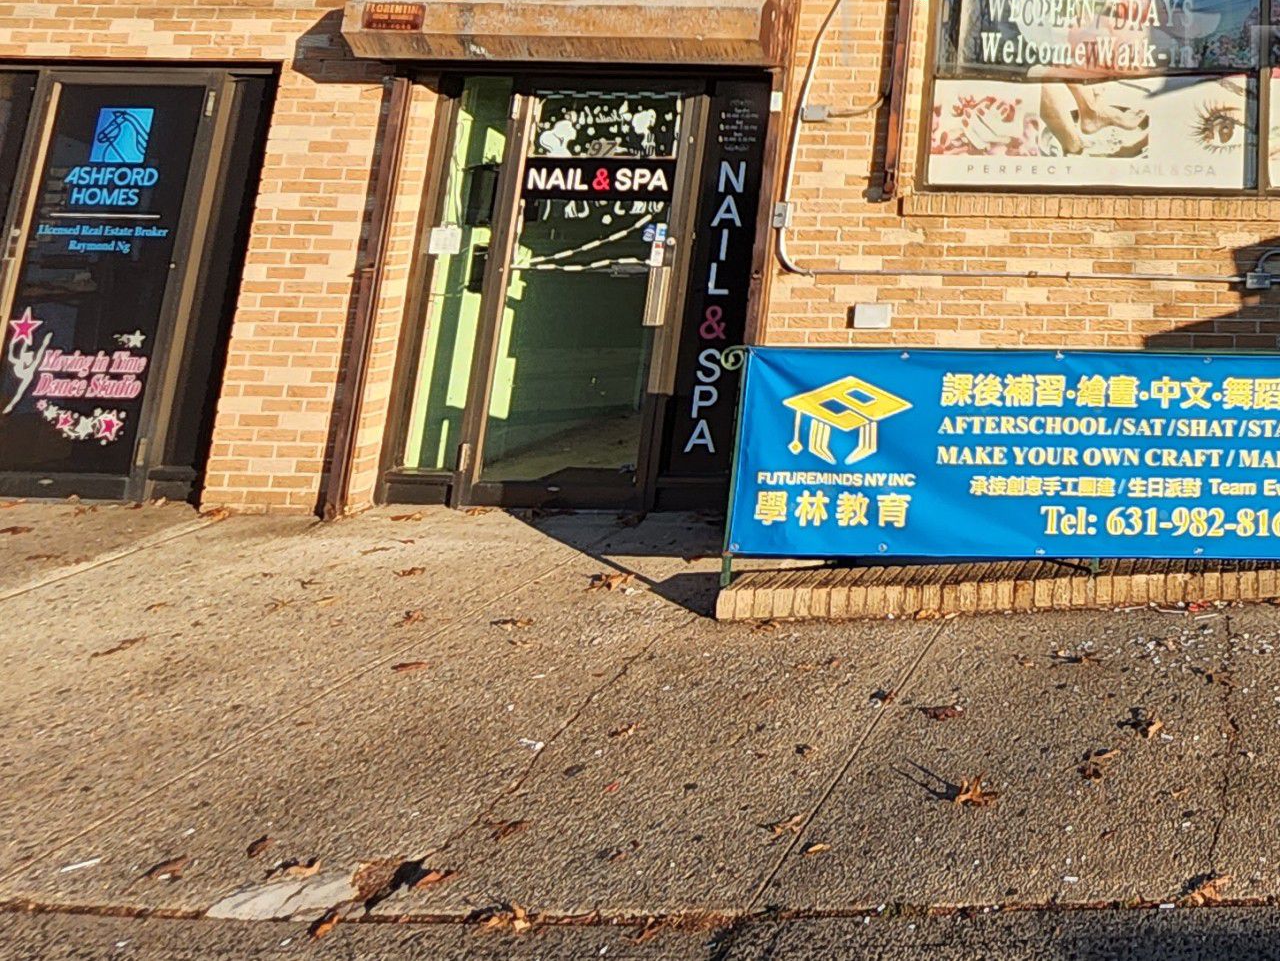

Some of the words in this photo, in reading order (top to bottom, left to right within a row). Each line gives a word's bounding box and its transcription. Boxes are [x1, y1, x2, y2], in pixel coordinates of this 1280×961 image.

[981, 32, 1086, 65] Welcome
[1096, 37, 1196, 69] Walk-in
[64, 167, 159, 186] ASHFORD
[527, 167, 588, 191] NAIL
[592, 168, 610, 191] &
[614, 168, 669, 191] SPA
[966, 164, 1072, 176] PERFECT
[70, 188, 139, 206] HOMES
[38, 224, 80, 235] Licensed
[81, 225, 102, 235] Real
[103, 225, 133, 236] Estate
[134, 226, 168, 236] Broker
[68, 240, 115, 253] Raymond
[115, 240, 131, 253] Ng
[38, 350, 95, 377] Moving
[109, 351, 147, 373] Time
[32, 372, 88, 396] Dance
[85, 373, 142, 398] Studio
[936, 446, 1007, 467] MAKE
[1012, 447, 1078, 467] YOUR
[1082, 447, 1140, 467] OWN
[1144, 448, 1223, 468] CRAFT
[757, 471, 863, 487] FUTUREMINDS
[864, 473, 887, 487] NY
[888, 473, 917, 487] INC
[1208, 478, 1257, 495] Team
[754, 490, 912, 528] 學林教育
[1040, 505, 1098, 536] Tel:
